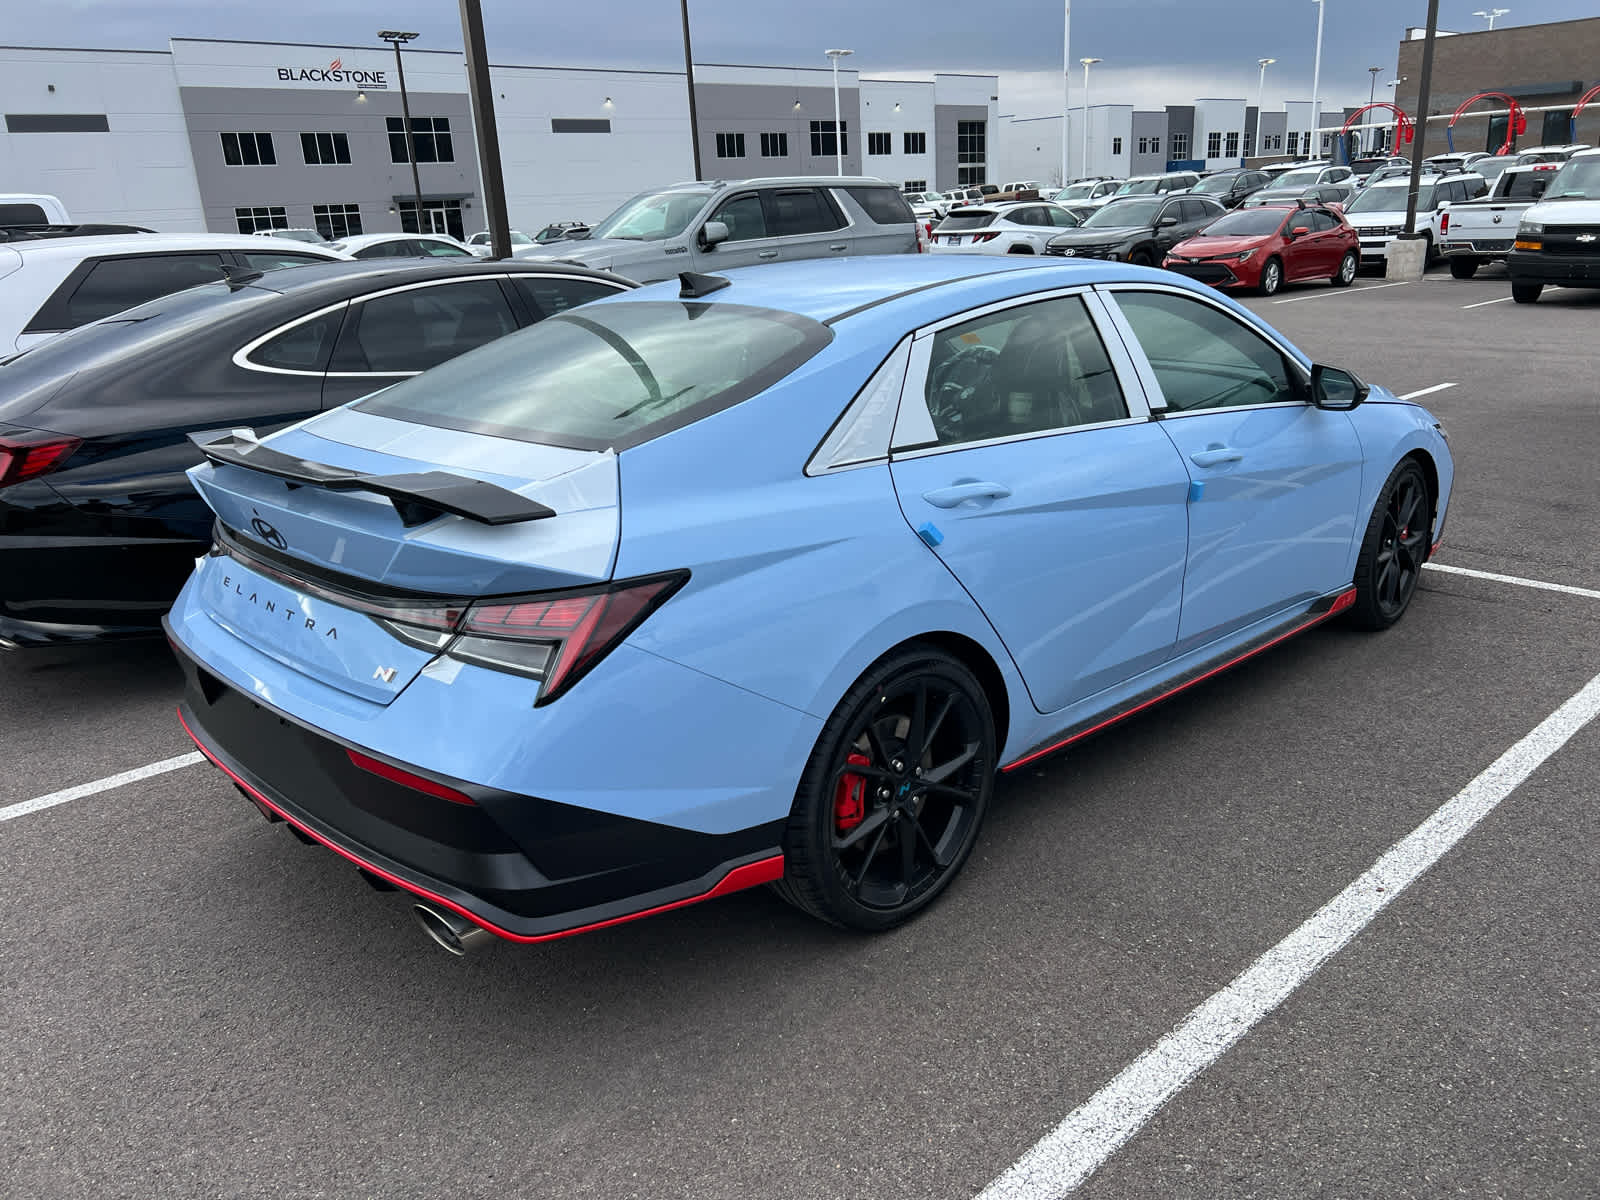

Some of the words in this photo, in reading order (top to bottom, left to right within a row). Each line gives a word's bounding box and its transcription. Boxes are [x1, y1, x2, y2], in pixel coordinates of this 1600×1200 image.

[277, 68, 387, 84] BLACKSTONE
[223, 576, 338, 640] ELANTRA
[372, 665, 398, 683] N
